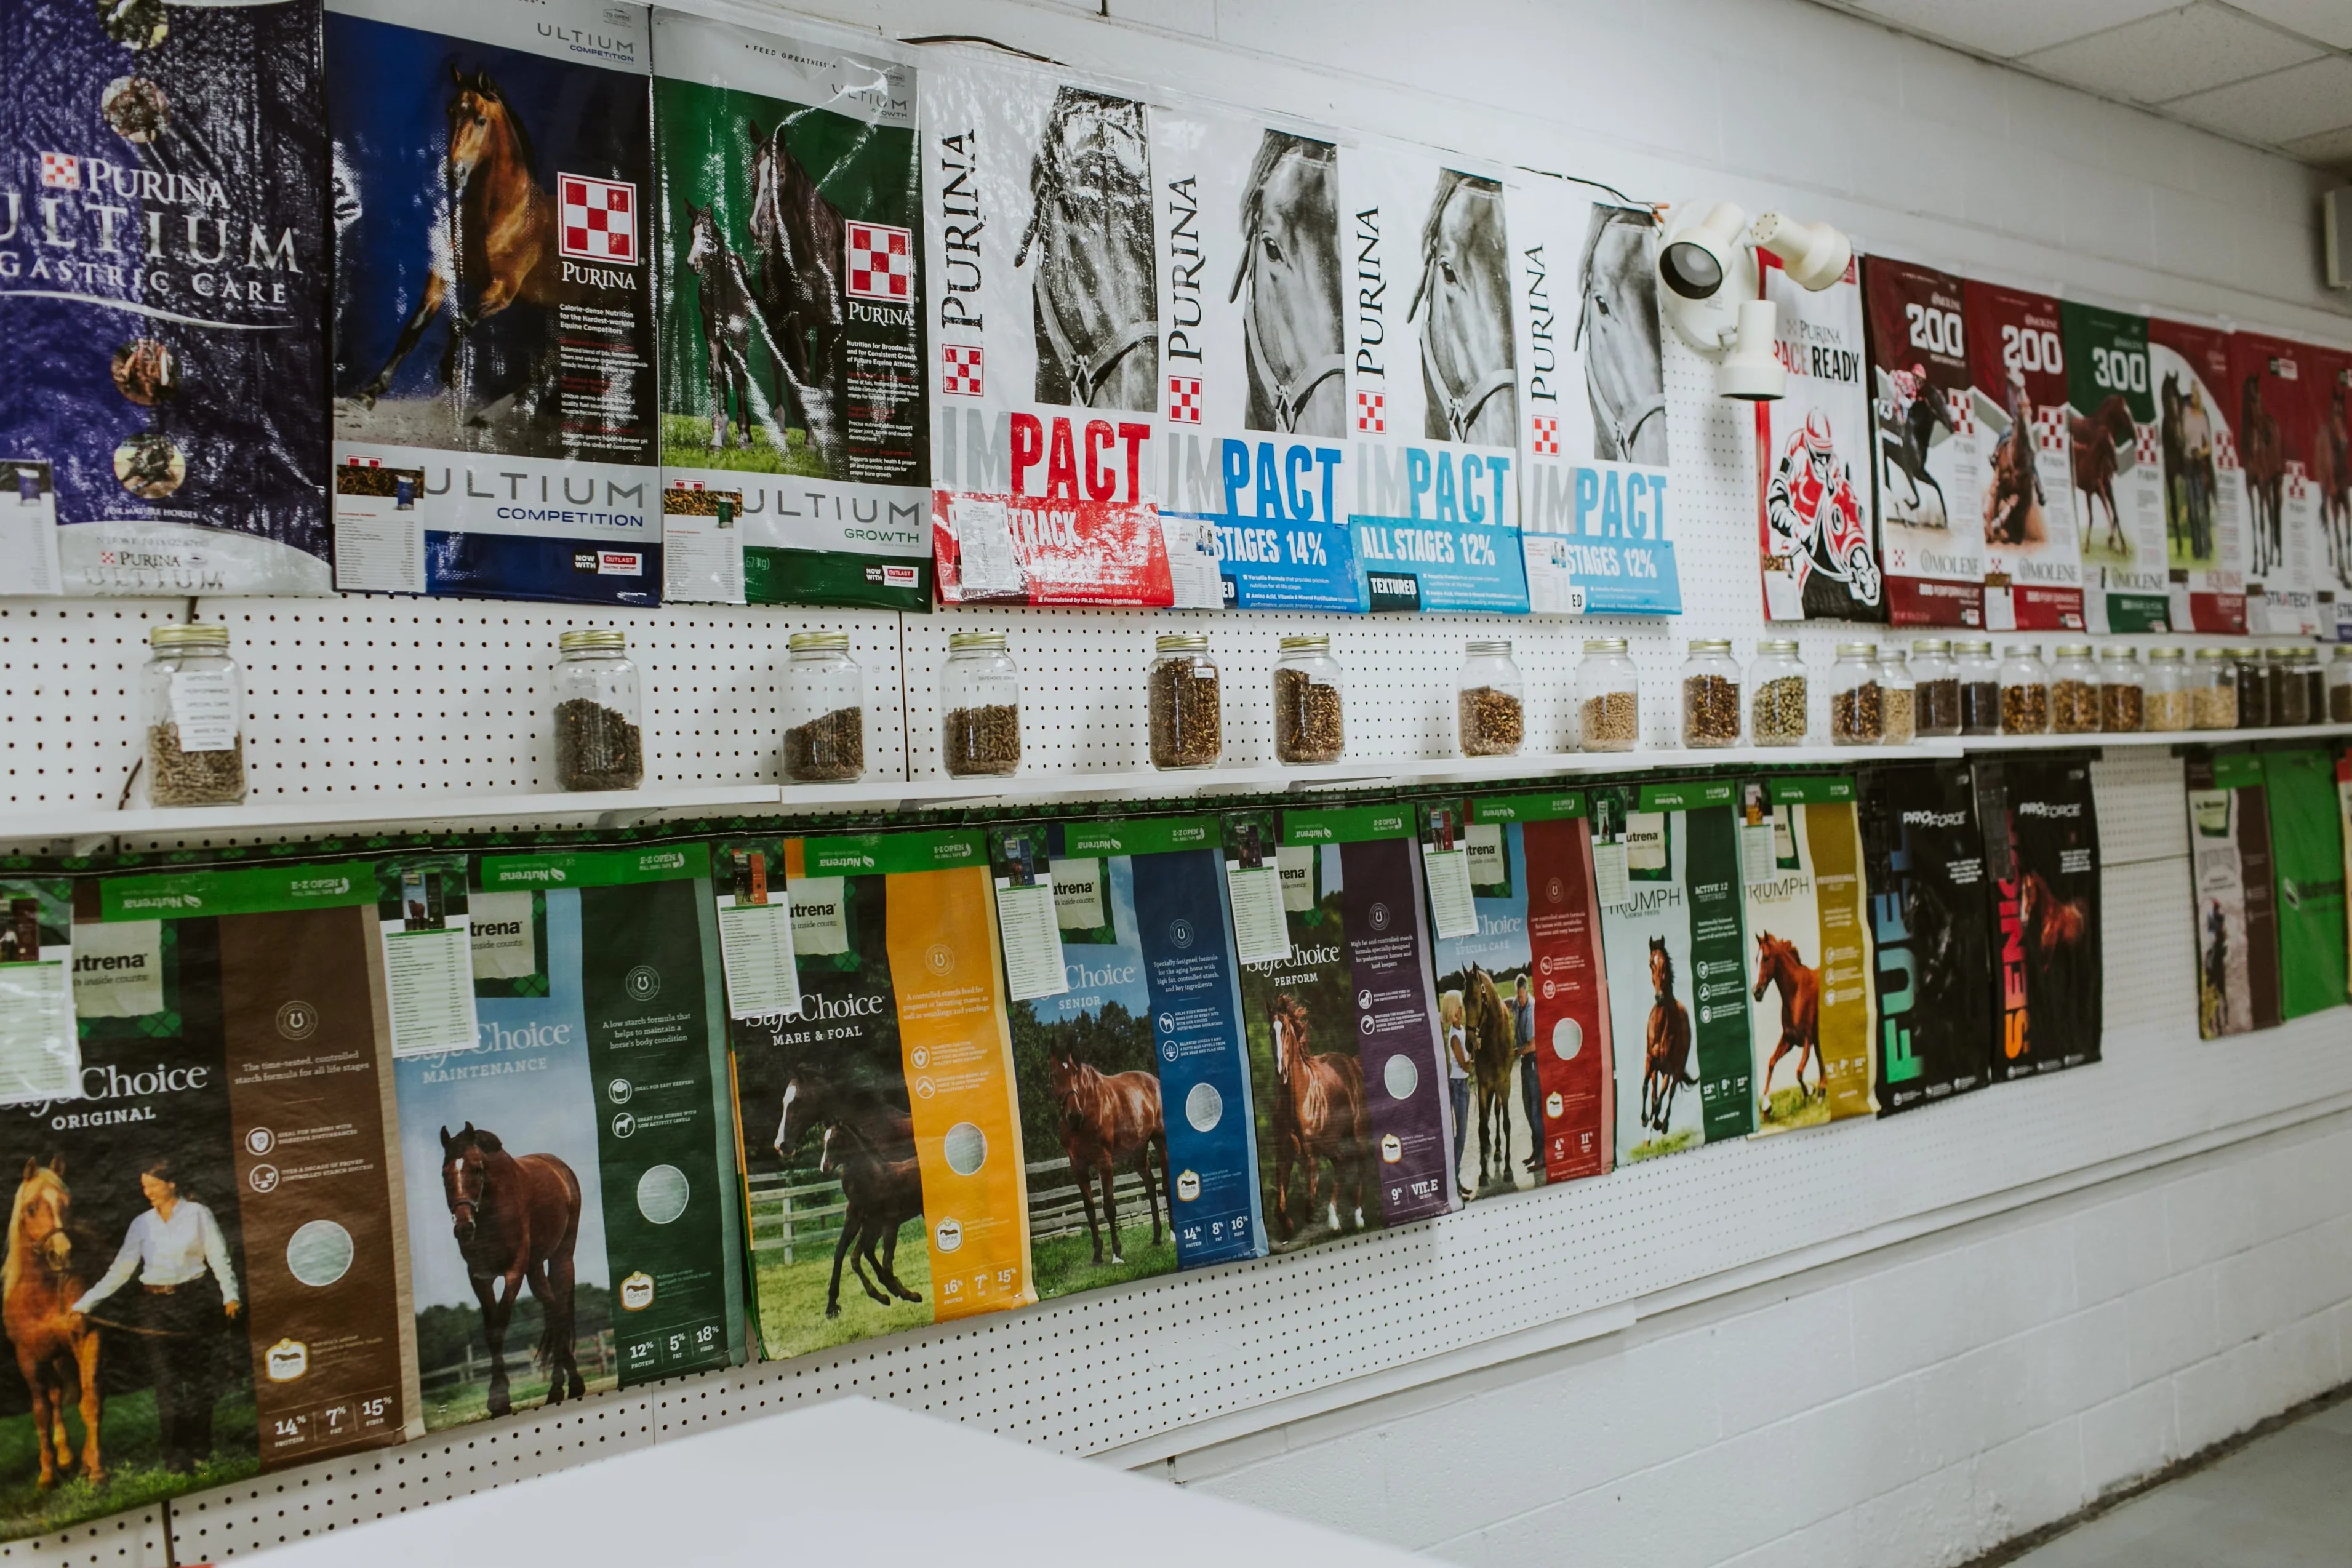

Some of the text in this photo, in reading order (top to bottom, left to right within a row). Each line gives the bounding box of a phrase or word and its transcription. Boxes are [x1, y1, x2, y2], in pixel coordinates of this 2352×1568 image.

[537, 23, 633, 54] ULTIUM
[570, 44, 634, 62] COMPETITION
[753, 46, 827, 68] FEED GREATNESS
[86, 158, 230, 209] PURINA
[942, 129, 986, 332] PURINA
[0, 251, 286, 303] GASTRIC CARE
[561, 262, 636, 290] PURINA
[1169, 175, 1206, 364] PURINA
[1356, 206, 1386, 380] PURINA
[559, 303, 634, 318] Calorie-dense Nutrition
[583, 316, 634, 327] Hardest-working
[848, 302, 914, 327] PURINA
[561, 321, 623, 334] Equine Competitors
[1524, 243, 1558, 405] PURINA
[1800, 320, 1841, 344] PURINA
[1906, 303, 1964, 358] 200
[847, 340, 871, 348] Nutrition
[868, 350, 897, 359] Consistent
[2002, 324, 2063, 374] 200
[1812, 346, 1859, 383] READY
[2093, 346, 2146, 393] 300
[942, 406, 1150, 503] IMPACT
[420, 466, 642, 508] ULTIUM
[1167, 432, 1342, 523] IMPACT
[1358, 442, 1510, 527] IMPACT
[738, 488, 919, 526] ULTIUM
[1532, 463, 1667, 541] IMPACT
[497, 507, 642, 527] COMPETITION
[1008, 508, 1082, 548] TRACK
[844, 528, 919, 543] GROWTH
[1214, 525, 1327, 566] STAGES 14%
[1361, 527, 1496, 566] ALL STAGES 12%
[120, 551, 181, 568] PURINA
[575, 554, 595, 562] NOW
[575, 561, 596, 569] WITH
[1567, 545, 1657, 578] STAGES 12%
[1921, 548, 1979, 575] OMOLENE
[1370, 577, 1417, 596] TEXTURED
[2265, 590, 2311, 607] STRATEGY
[1078, 839, 1110, 849] Nutrena
[1295, 828, 1323, 838] Nutrena
[1627, 832, 1658, 842] utrena
[820, 858, 861, 868] Nutrena
[500, 870, 548, 881] Nutrena
[1695, 884, 1719, 894] ACTIVE
[1745, 878, 1809, 904] RIUMPH
[123, 895, 182, 910] Nutrena
[1610, 889, 1681, 918] TRIUMPH
[1362, 953, 1388, 962] performance
[1372, 945, 1391, 953] specially
[1391, 942, 1410, 950] designed
[1455, 940, 1510, 956] SPECIAL CARE
[1154, 960, 1175, 968] Specially
[1176, 957, 1198, 965] designed
[1274, 972, 1318, 987] PERFORM
[1058, 995, 1101, 1010] SENIOR
[625, 1017, 646, 1026] starch
[647, 1014, 676, 1025] formula
[610, 1034, 687, 1049] horse's body condition
[615, 1030, 634, 1039] helps
[644, 1025, 676, 1034] maintain
[773, 1026, 863, 1046] MARE & FOAL
[422, 1057, 548, 1084] MAINTENANCE
[51, 1106, 156, 1131] ORIGINAL
[1391, 1179, 1438, 1201] 9% VIT. E
[1184, 1216, 1248, 1240] 14% 8% 16%
[944, 1267, 1017, 1295] 16% 7% 15%
[630, 1326, 719, 1359] 12% 5% 18%
[631, 1359, 655, 1369] PROTEIN
[275, 1396, 393, 1435] 14% 7% 15%
